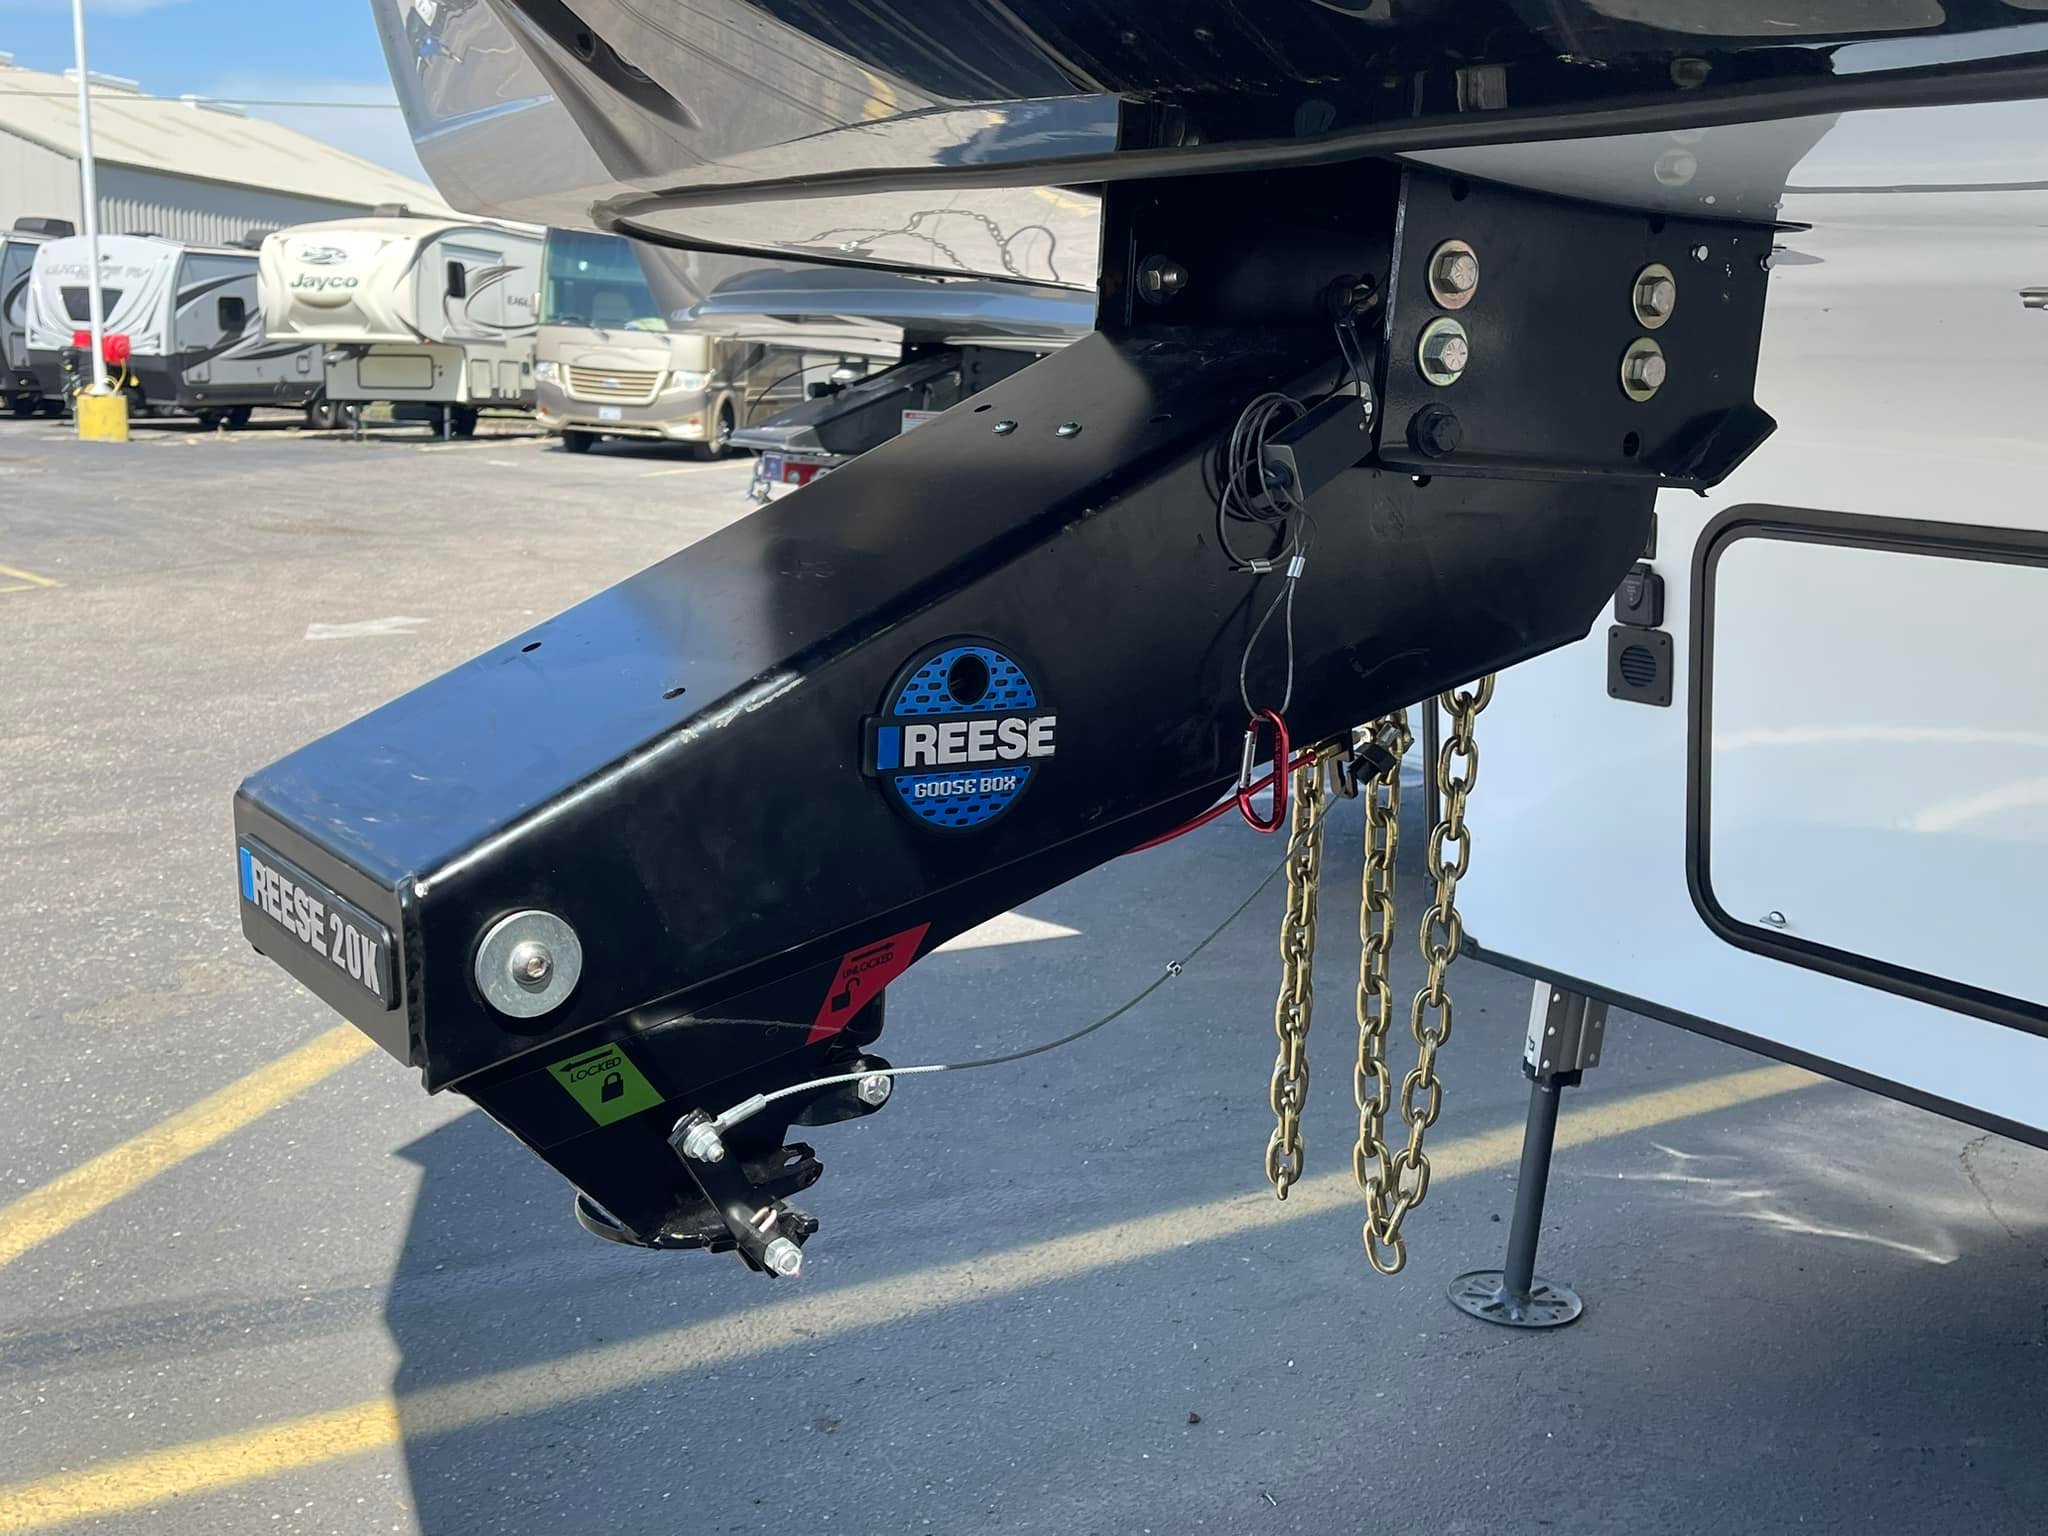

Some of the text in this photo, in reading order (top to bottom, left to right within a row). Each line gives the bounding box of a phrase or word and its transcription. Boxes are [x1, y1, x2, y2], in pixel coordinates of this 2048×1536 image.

[290, 273, 359, 291] Jayco
[904, 716, 1057, 768] REESE
[914, 775, 1017, 798] GOOSE BOX
[251, 855, 381, 996] REESE 20K
[842, 951, 894, 979] UNLOCKED
[570, 1056, 622, 1084] LOCKED
